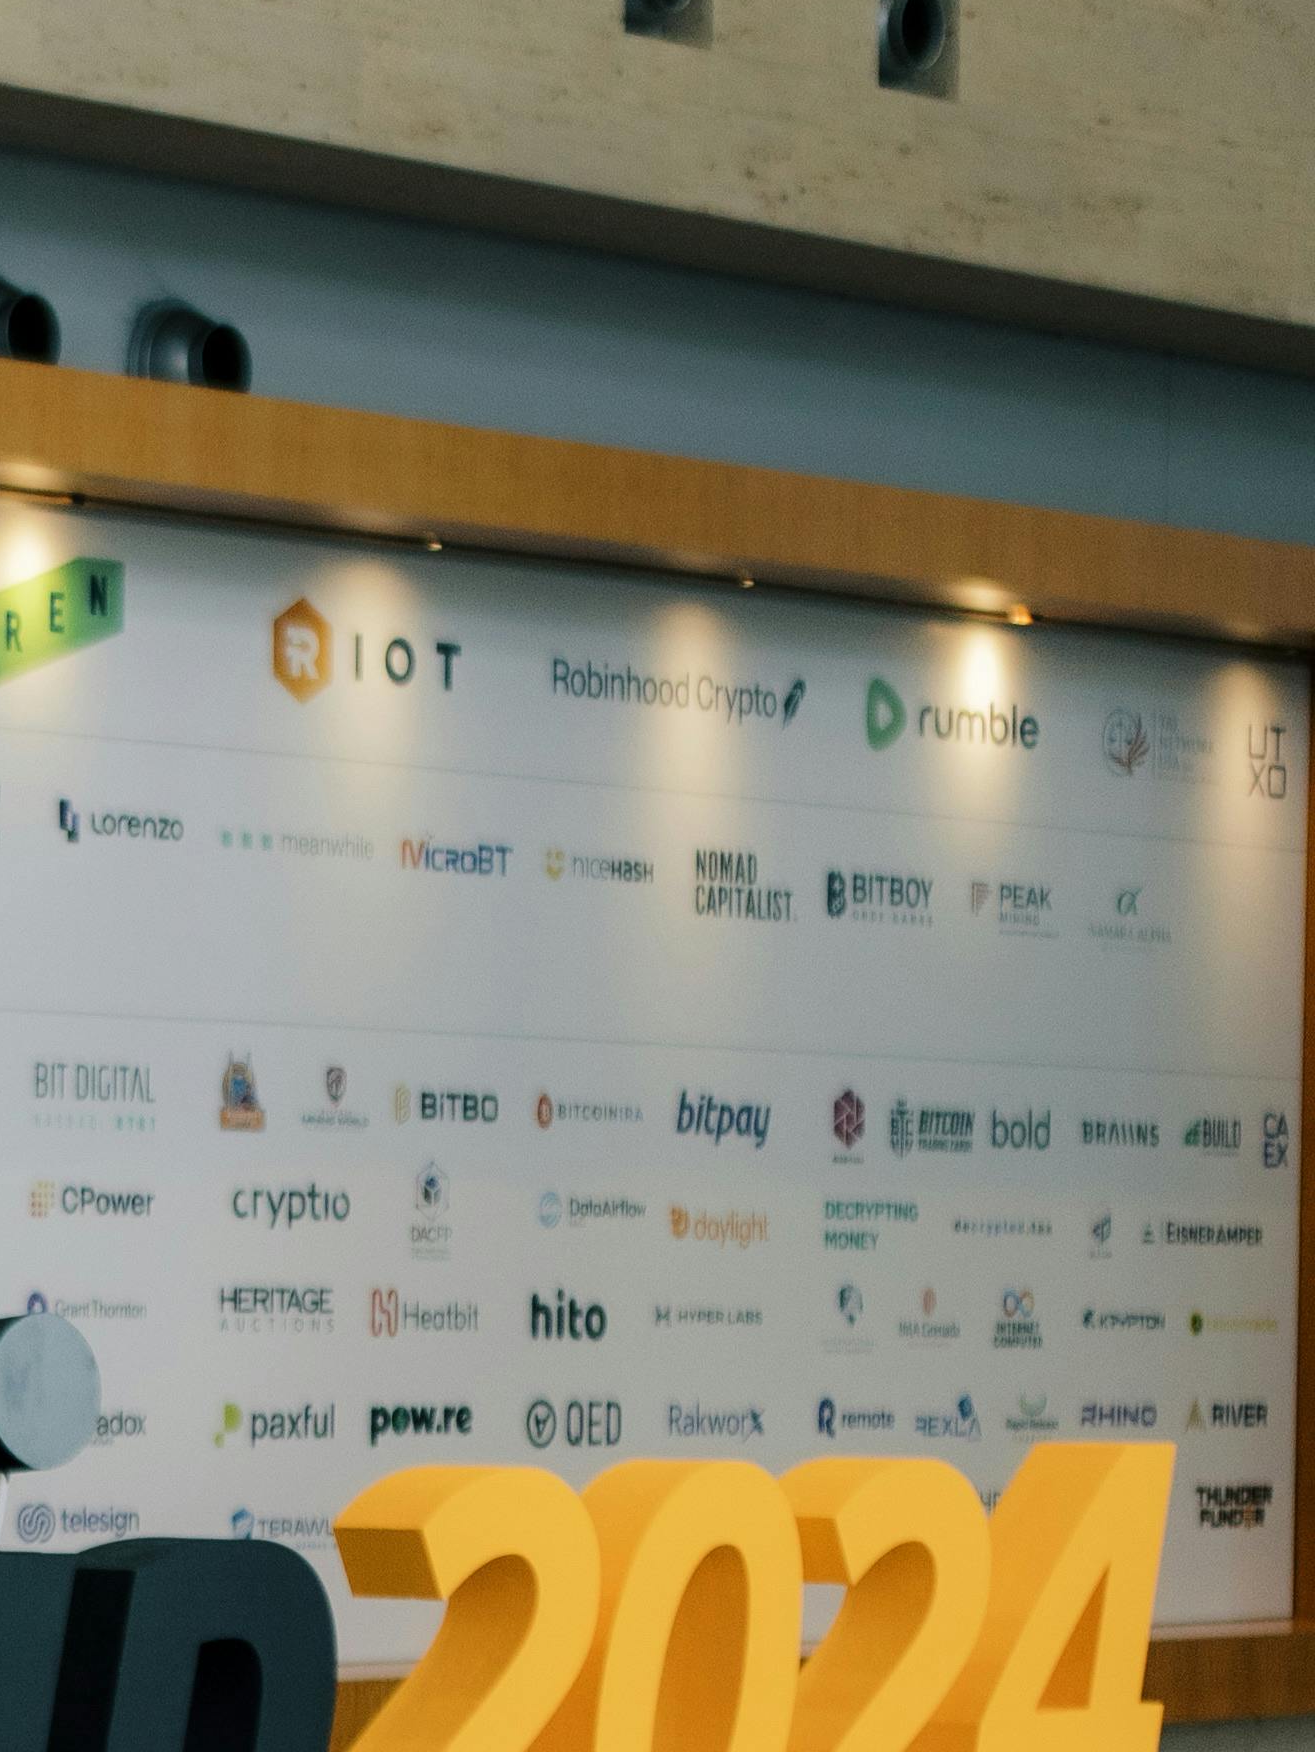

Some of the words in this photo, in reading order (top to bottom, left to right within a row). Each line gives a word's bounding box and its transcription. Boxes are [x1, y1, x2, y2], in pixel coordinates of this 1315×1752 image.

[552, 657, 690, 709] Robinhood
[697, 675, 778, 724] Crypto
[919, 703, 1040, 749] rumble
[695, 849, 758, 883] NOMAD
[852, 873, 933, 910] BITBOY
[999, 882, 1052, 912] PEAK
[35, 1061, 66, 1099] BIT
[75, 1064, 156, 1104] DIGITAL
[676, 1088, 770, 1148] bitpay
[991, 1106, 1051, 1151] bold
[61, 1185, 155, 1216] CPower
[232, 1183, 351, 1229] cryptio
[825, 1200, 919, 1222] DECRYPTING
[693, 1211, 771, 1247] daylight
[825, 1230, 879, 1249] MONEY
[219, 1287, 334, 1315] HERITAGE
[403, 1300, 480, 1333] Heatbit
[530, 1289, 608, 1341] hito
[219, 1317, 335, 1335] AUCTIONS
[251, 1402, 336, 1448] paxful
[370, 1401, 473, 1447] pow.re
[565, 1399, 623, 1447] QED
[842, 1410, 896, 1431] remote
[1211, 1402, 1269, 1428] RIVER
[61, 1506, 140, 1534] telesign
